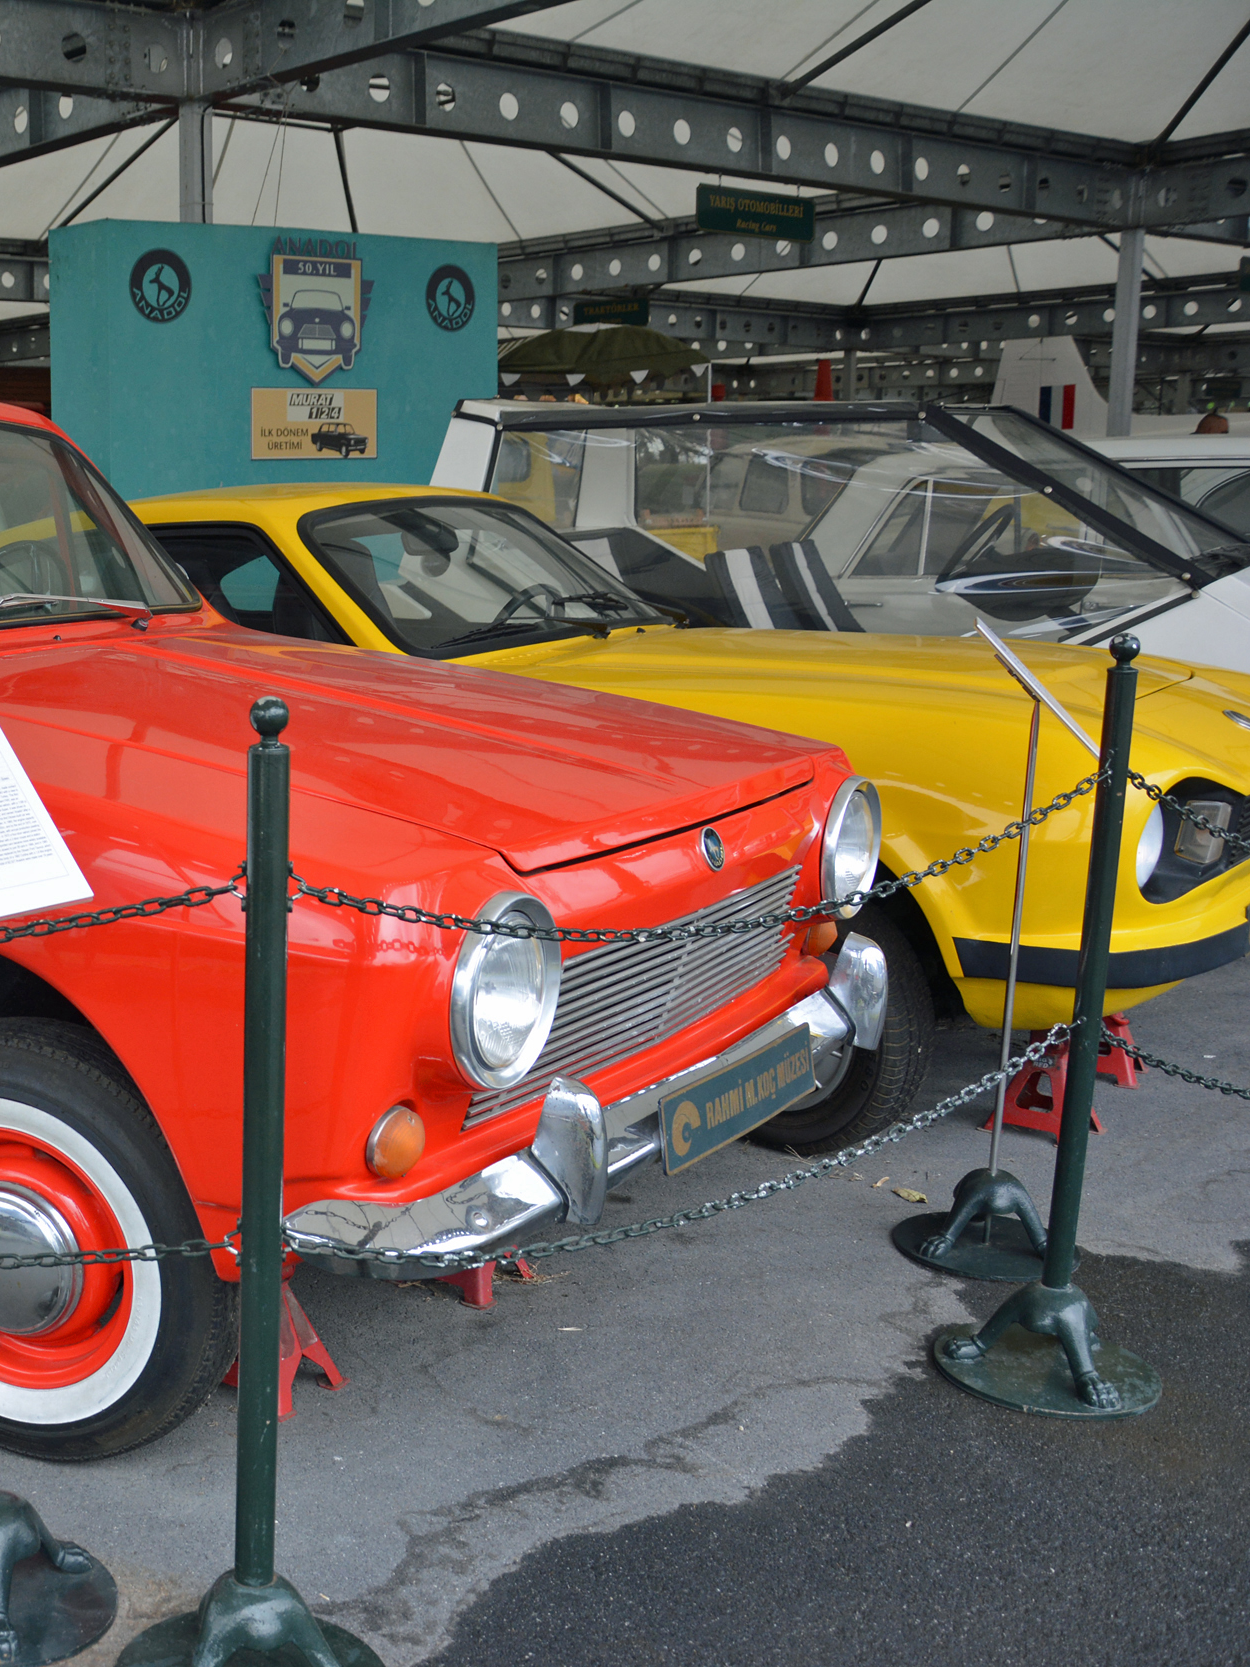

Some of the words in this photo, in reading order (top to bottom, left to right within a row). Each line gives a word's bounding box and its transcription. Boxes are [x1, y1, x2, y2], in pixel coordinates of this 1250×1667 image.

[710, 194, 735, 212] YARIŞ
[738, 199, 804, 218] OTOMOBİLLERİ
[736, 218, 759, 232] Racing
[761, 221, 777, 232] Cars
[298, 262, 337, 275] 50.YIL
[133, 288, 189, 319] ANADOL
[428, 298, 473, 329] ANADOL
[290, 393, 334, 406] MURAT
[309, 407, 341, 419] 124
[260, 426, 274, 438] İLK
[276, 427, 308, 438] DÖNEM
[268, 440, 302, 450] ÜRETİMİ
[706, 1079, 744, 1130] RAHMİ
[777, 1041, 810, 1089] MÜZESİ
